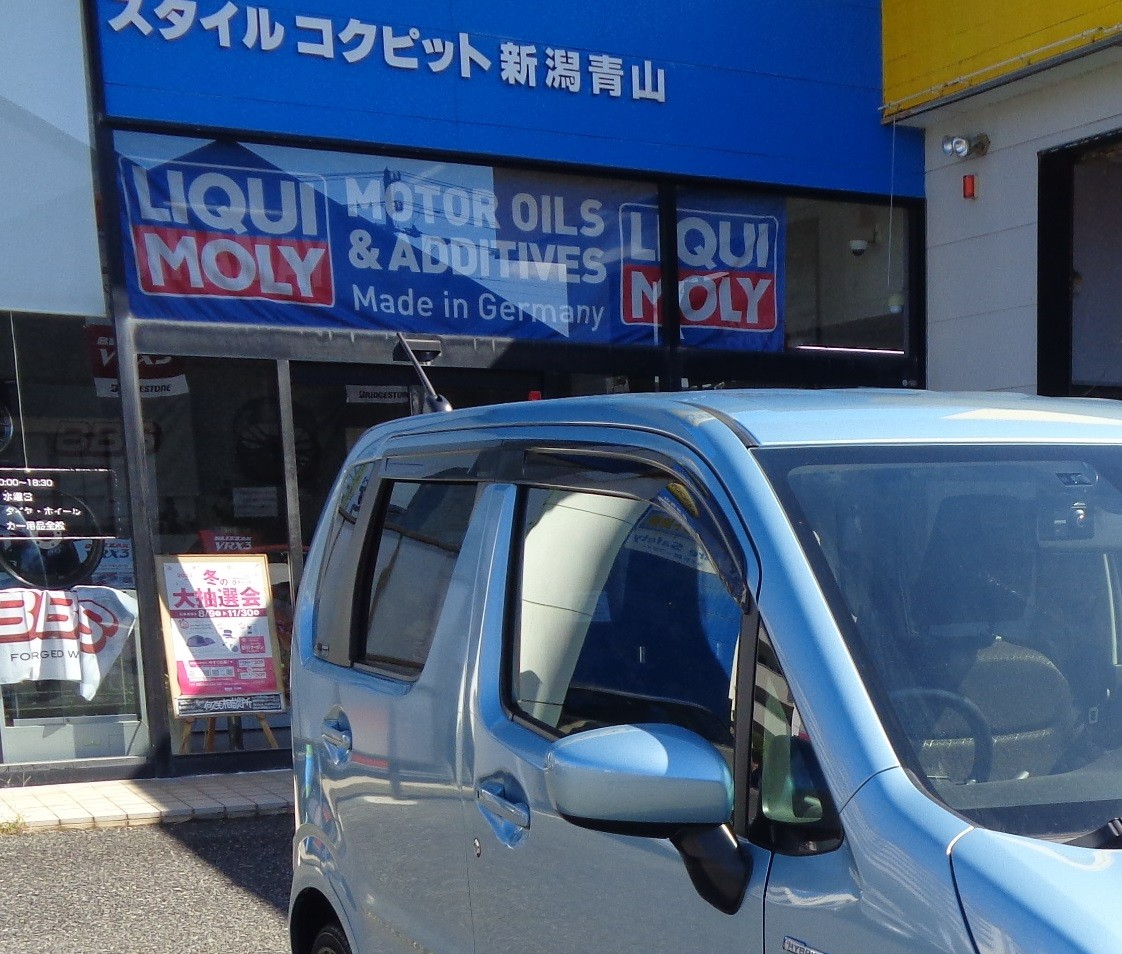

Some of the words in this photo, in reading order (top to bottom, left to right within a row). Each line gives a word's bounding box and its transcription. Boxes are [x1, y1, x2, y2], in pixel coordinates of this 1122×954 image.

[296, 15, 492, 78] コクピット
[500, 41, 667, 103] 新潟青山
[131, 165, 318, 236] LIQUI
[344, 176, 500, 229] MOTOR
[511, 192, 605, 237] OILS
[143, 232, 326, 298] MOLY
[348, 229, 382, 270] &
[388, 231, 607, 284] ADDITIVES
[352, 284, 434, 317] Made
[444, 291, 468, 319] in
[478, 292, 604, 332] Germany
[214, 541, 252, 551] VRX3
[172, 586, 262, 609] 大抽選会
[203, 569, 228, 586] 冬の
[10, 649, 65, 662] FORGED
